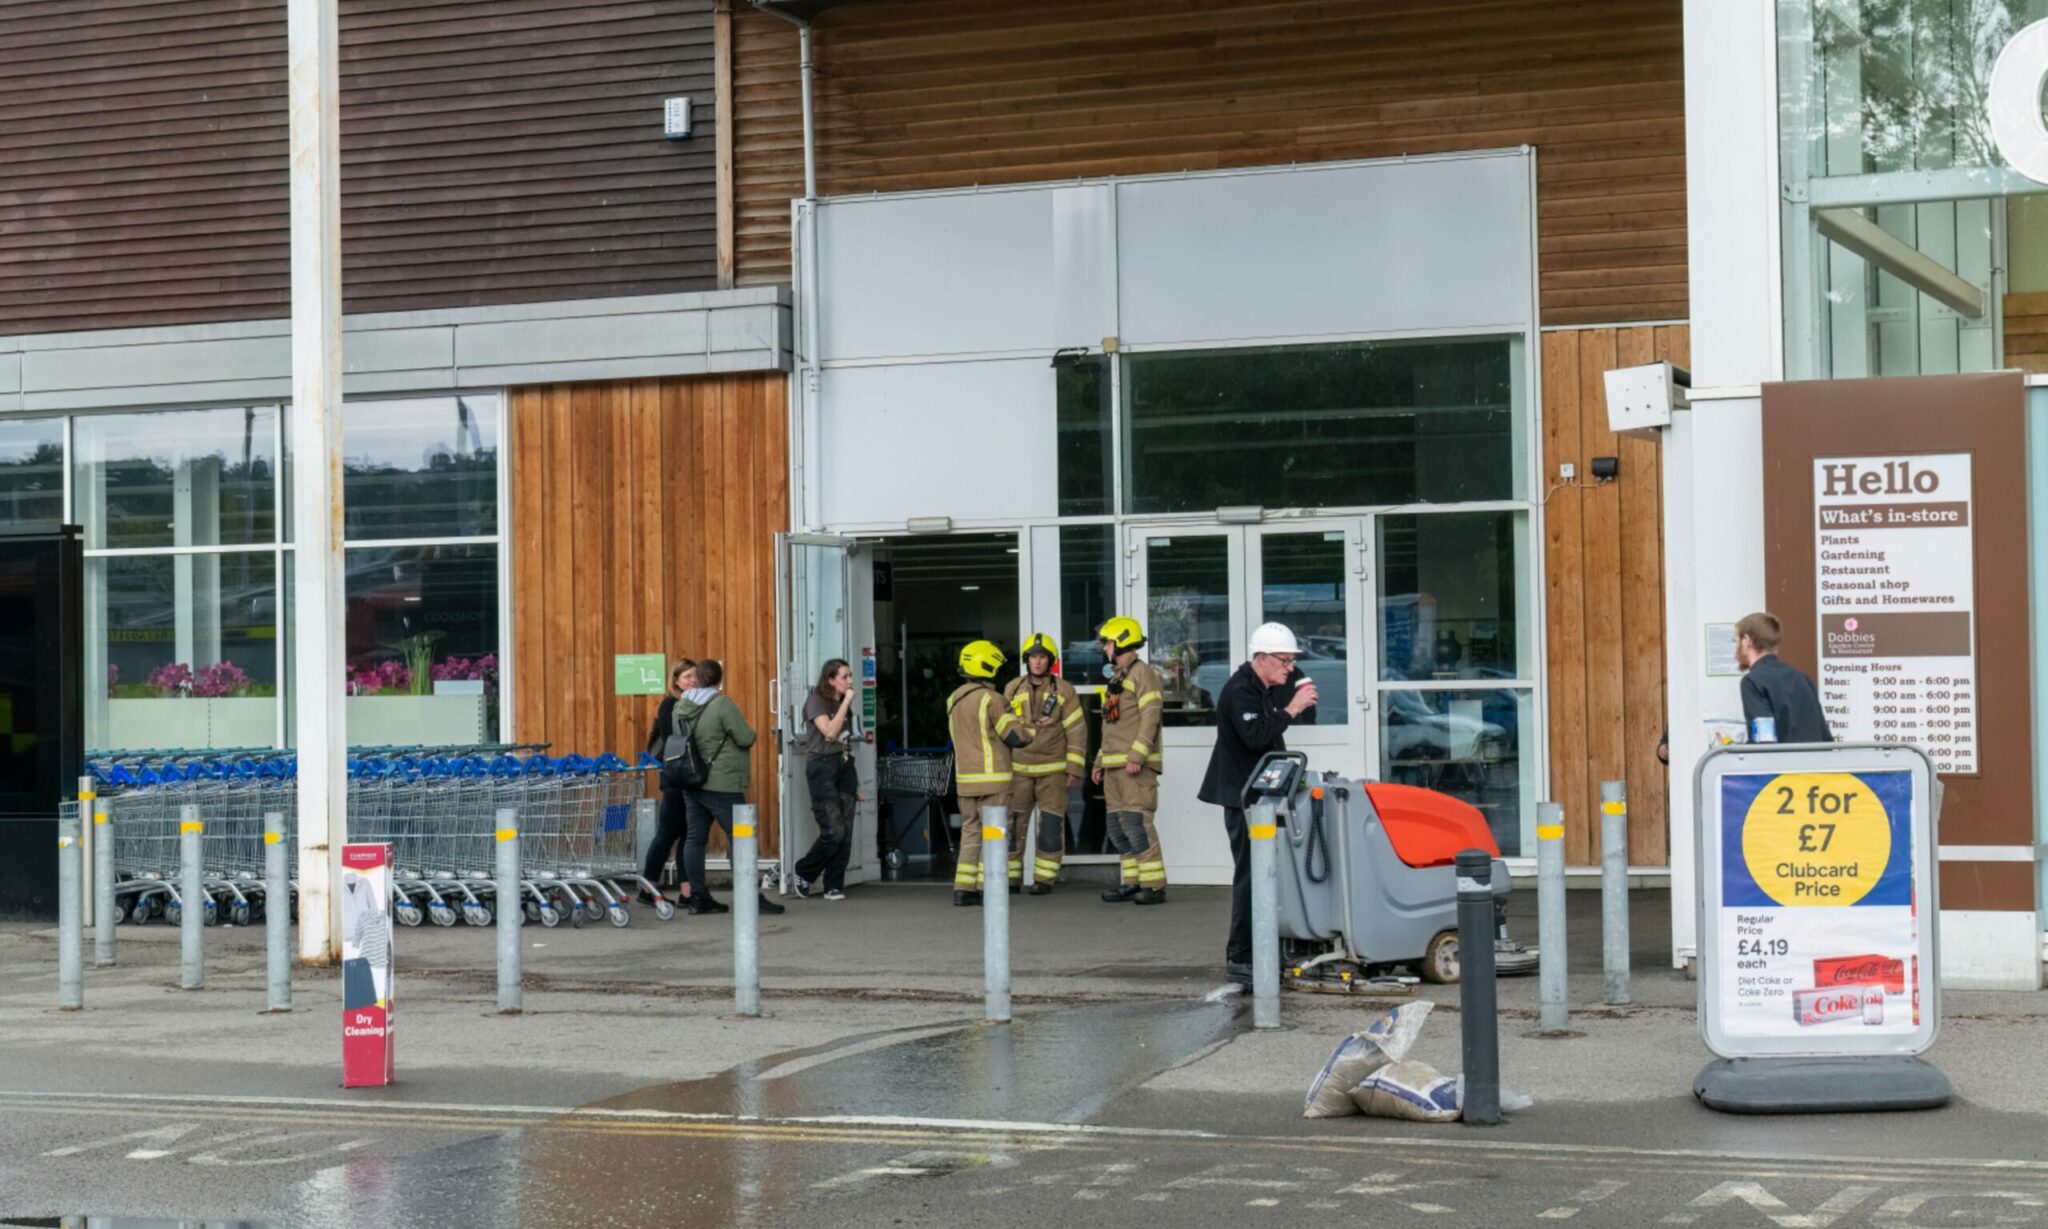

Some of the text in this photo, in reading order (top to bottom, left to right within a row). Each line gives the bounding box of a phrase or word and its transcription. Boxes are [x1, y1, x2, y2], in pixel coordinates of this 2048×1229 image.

[1822, 461, 1939, 496] Hello
[1821, 508, 1959, 524] What's in-store
[1820, 535, 1860, 545] Plants
[1821, 550, 1886, 561] Gardening
[1821, 565, 1890, 575] Restaurant
[1821, 579, 1910, 592] Seasonal shop
[1822, 595, 1955, 605] Gifts and Homewares
[1828, 632, 1875, 642] Dobbies
[1824, 663, 1902, 673] Opening Hours
[1824, 678, 1850, 686] Mon:
[1872, 677, 1897, 686] 9:00
[1925, 677, 1950, 685] 6:00
[1953, 679, 1970, 687] pm
[1824, 692, 1847, 700] Tue:
[1873, 692, 1897, 700] 9:00
[1926, 691, 1950, 700] 6:00
[1953, 693, 1970, 701] pm
[1824, 706, 1850, 714] Wed:
[1873, 706, 1897, 714] 9:00
[1926, 705, 1950, 714] 6:00
[1954, 707, 1970, 715] pm
[1826, 721, 1849, 729] Thu:
[1873, 720, 1898, 728] 9:00
[1927, 720, 1951, 728] 6:00
[1954, 722, 1971, 730] pm
[1832, 735, 1844, 743] ri:
[1874, 734, 1898, 743] 9:00
[1927, 734, 1951, 742] 6:00
[1954, 736, 1971, 744] pm
[1928, 748, 1971, 758] 6:00 pm
[1955, 764, 1972, 772] pm
[1776, 786, 1858, 815] 2 for
[1798, 824, 1836, 852] £7
[1776, 862, 1858, 878] Clubcard
[1795, 881, 1840, 897] Price
[1737, 914, 1775, 925] Regular
[1737, 926, 1763, 935] Price
[1738, 938, 1789, 956] £4.19
[1737, 959, 1767, 969] each
[1738, 976, 1756, 985] Diet
[1758, 976, 1781, 984] Coke
[1737, 988, 1784, 997] Coke Zero
[1814, 995, 1858, 1015] Coke
[356, 1014, 373, 1025] Dry
[345, 1025, 384, 1036] Cleaning
[40, 1123, 382, 1168] NO
